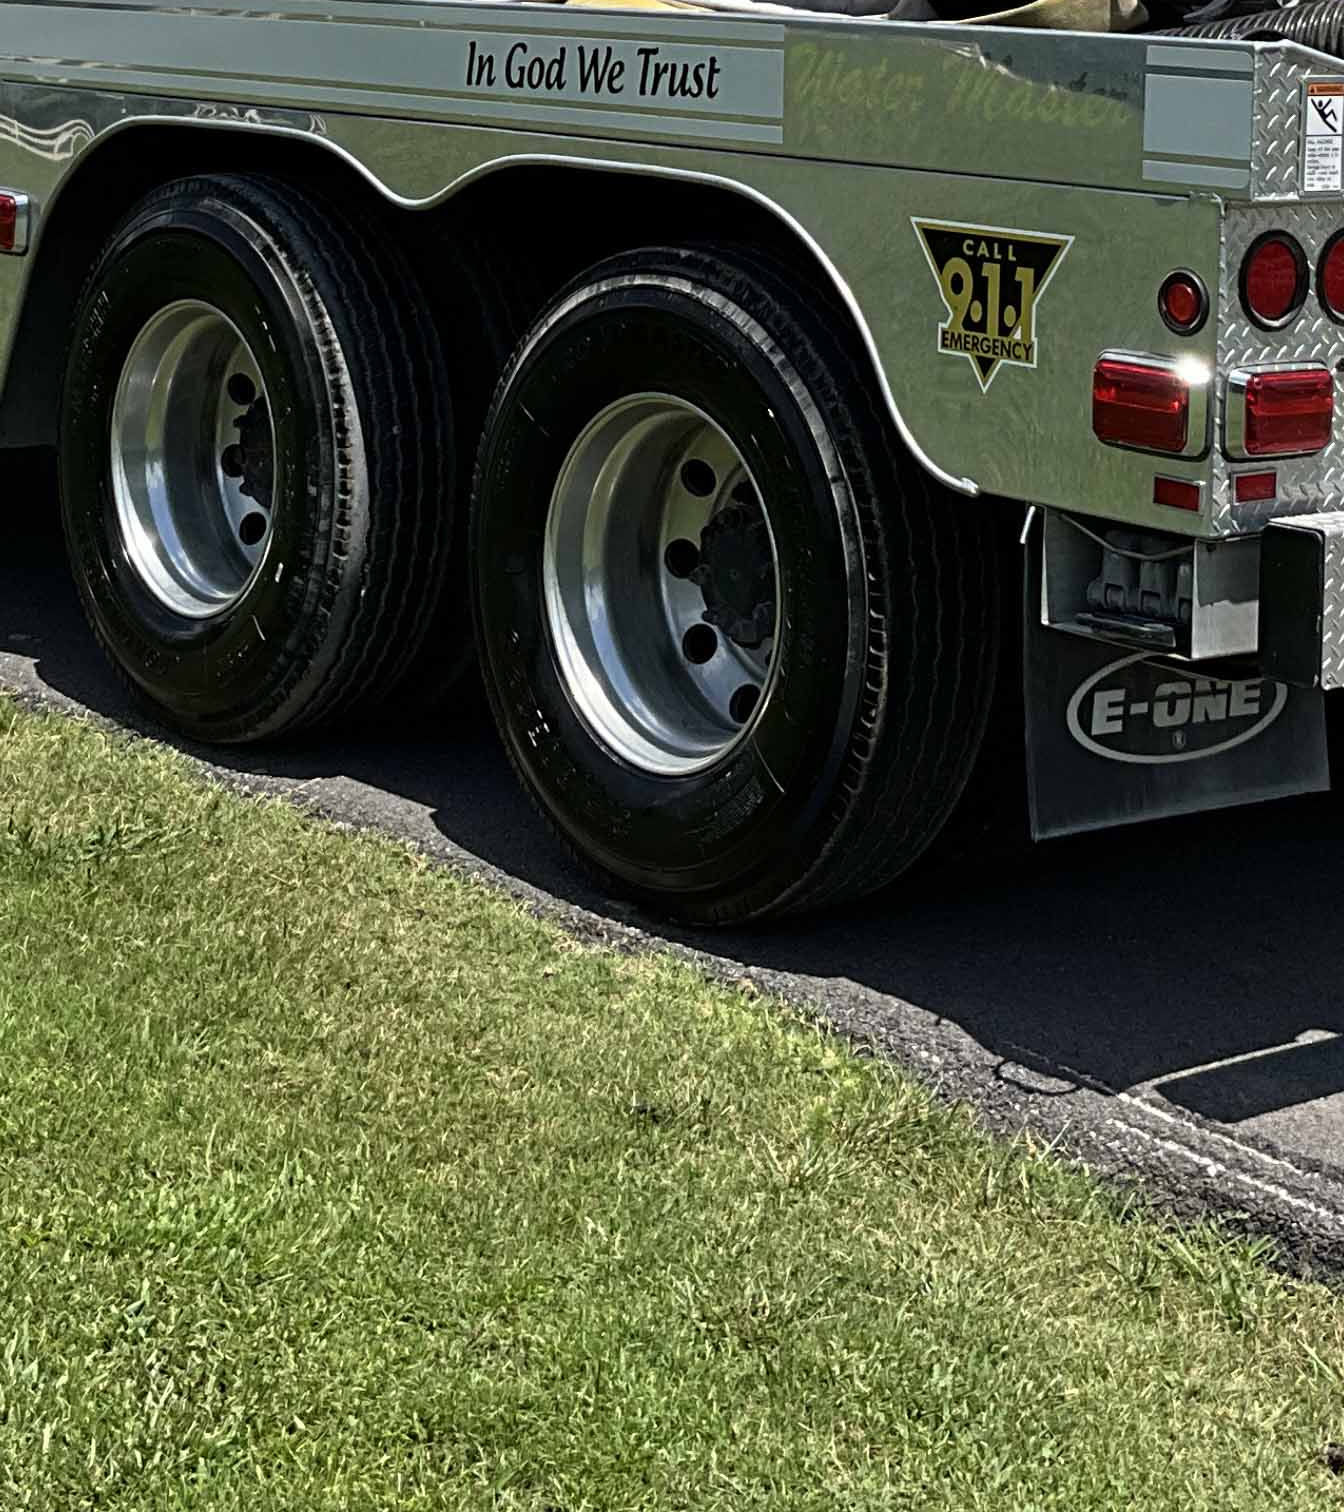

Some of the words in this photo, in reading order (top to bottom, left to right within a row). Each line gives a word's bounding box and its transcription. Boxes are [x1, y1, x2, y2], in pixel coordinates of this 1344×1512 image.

[465, 40, 497, 87] In
[505, 41, 568, 91] God
[577, 44, 625, 95] We
[636, 46, 722, 100] Trust
[962, 238, 1017, 262] CALL
[941, 329, 1034, 361] EMERGENCY
[1090, 678, 1262, 737] E-ONE
